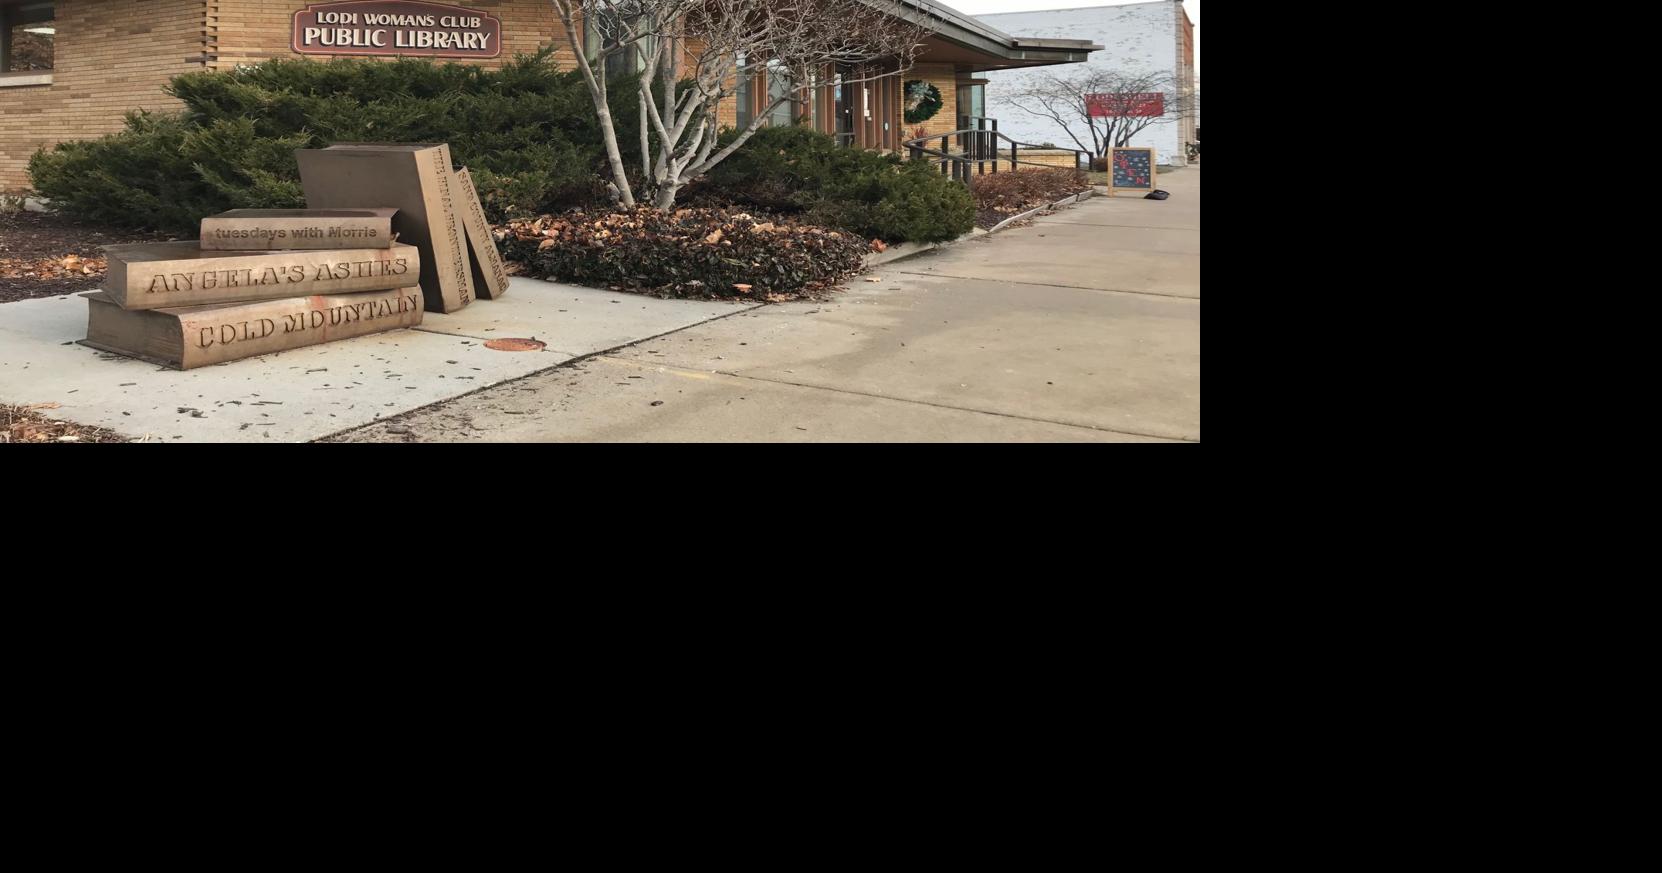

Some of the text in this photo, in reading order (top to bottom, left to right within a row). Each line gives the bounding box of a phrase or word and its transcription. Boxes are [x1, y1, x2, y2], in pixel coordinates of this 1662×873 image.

[317, 11, 481, 28] LODI WOMAN'S CLUB
[304, 27, 490, 49] PUBLIC LIBRARY
[215, 226, 377, 240] tuesdays with Morrie
[458, 171, 475, 202] SAND
[485, 245, 507, 291] ALMANAC
[146, 258, 408, 294] ANGELA'S ASHES
[197, 294, 418, 348] COLD MOUNTAIN
